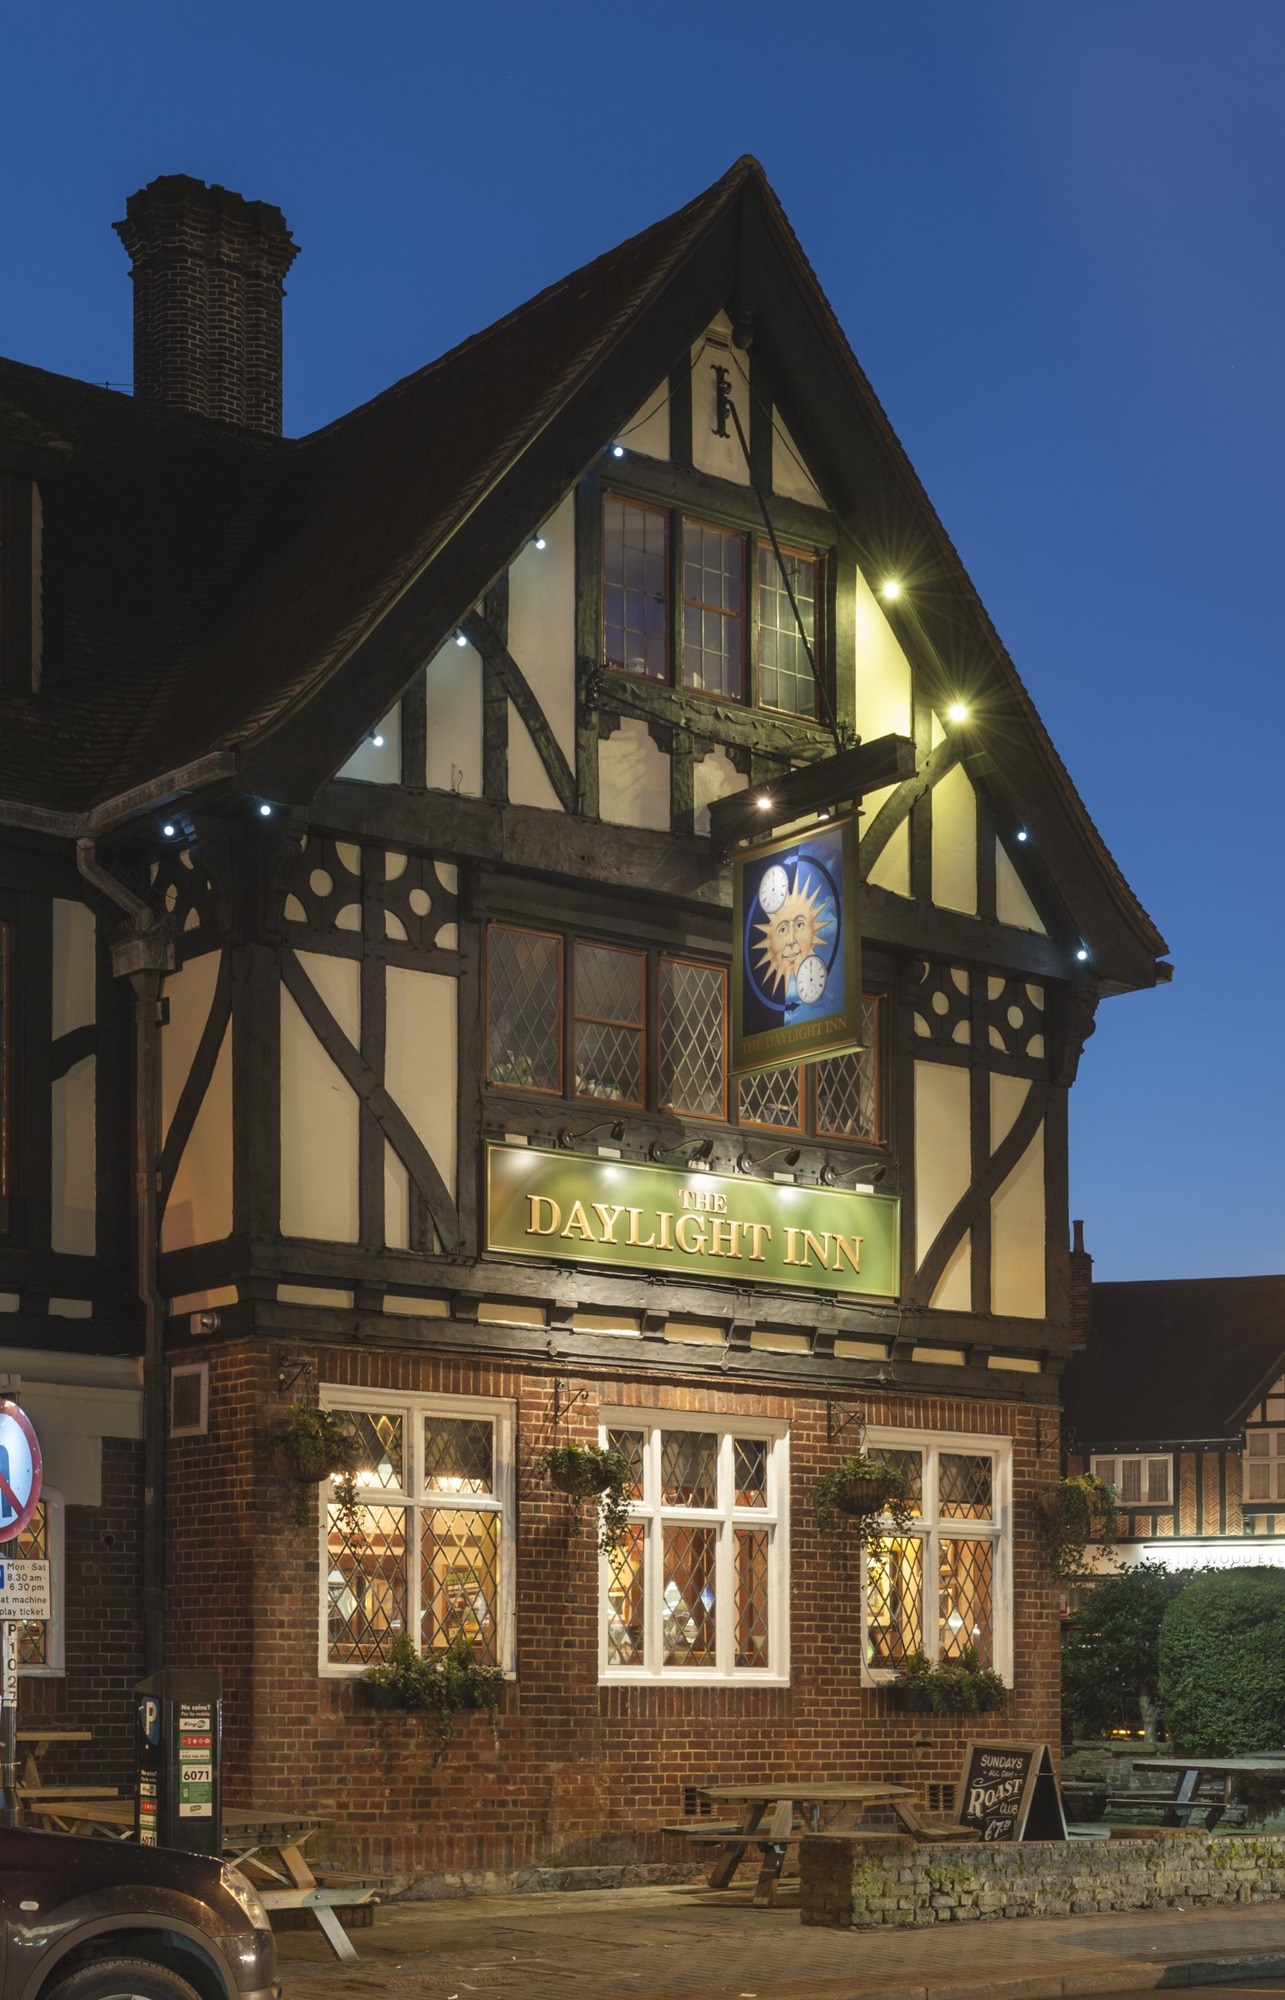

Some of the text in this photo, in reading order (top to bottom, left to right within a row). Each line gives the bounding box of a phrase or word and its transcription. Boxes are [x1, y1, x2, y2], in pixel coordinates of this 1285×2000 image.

[743, 1016, 847, 1055] THE DAYLIGHT INN
[678, 1189, 727, 1214] THE
[525, 1194, 864, 1273] DAYLIGHT INN
[1158, 1554, 1199, 1565] PETTS
[1205, 1554, 1252, 1565] WOOD
[7, 1563, 25, 1571] Mon
[32, 1563, 46, 1571] Sat
[7, 1573, 28, 1581] 8.30
[9, 1583, 30, 1591] 6.30
[1, 1596, 47, 1604] at machine
[20, 1608, 45, 1616] ticket
[145, 1701, 158, 1735] P
[980, 1754, 1024, 1769] SUNDAYS
[183, 1771, 210, 1780] 6071
[967, 1779, 1023, 1818] ROAST
[1000, 1802, 1018, 1814] CLUB
